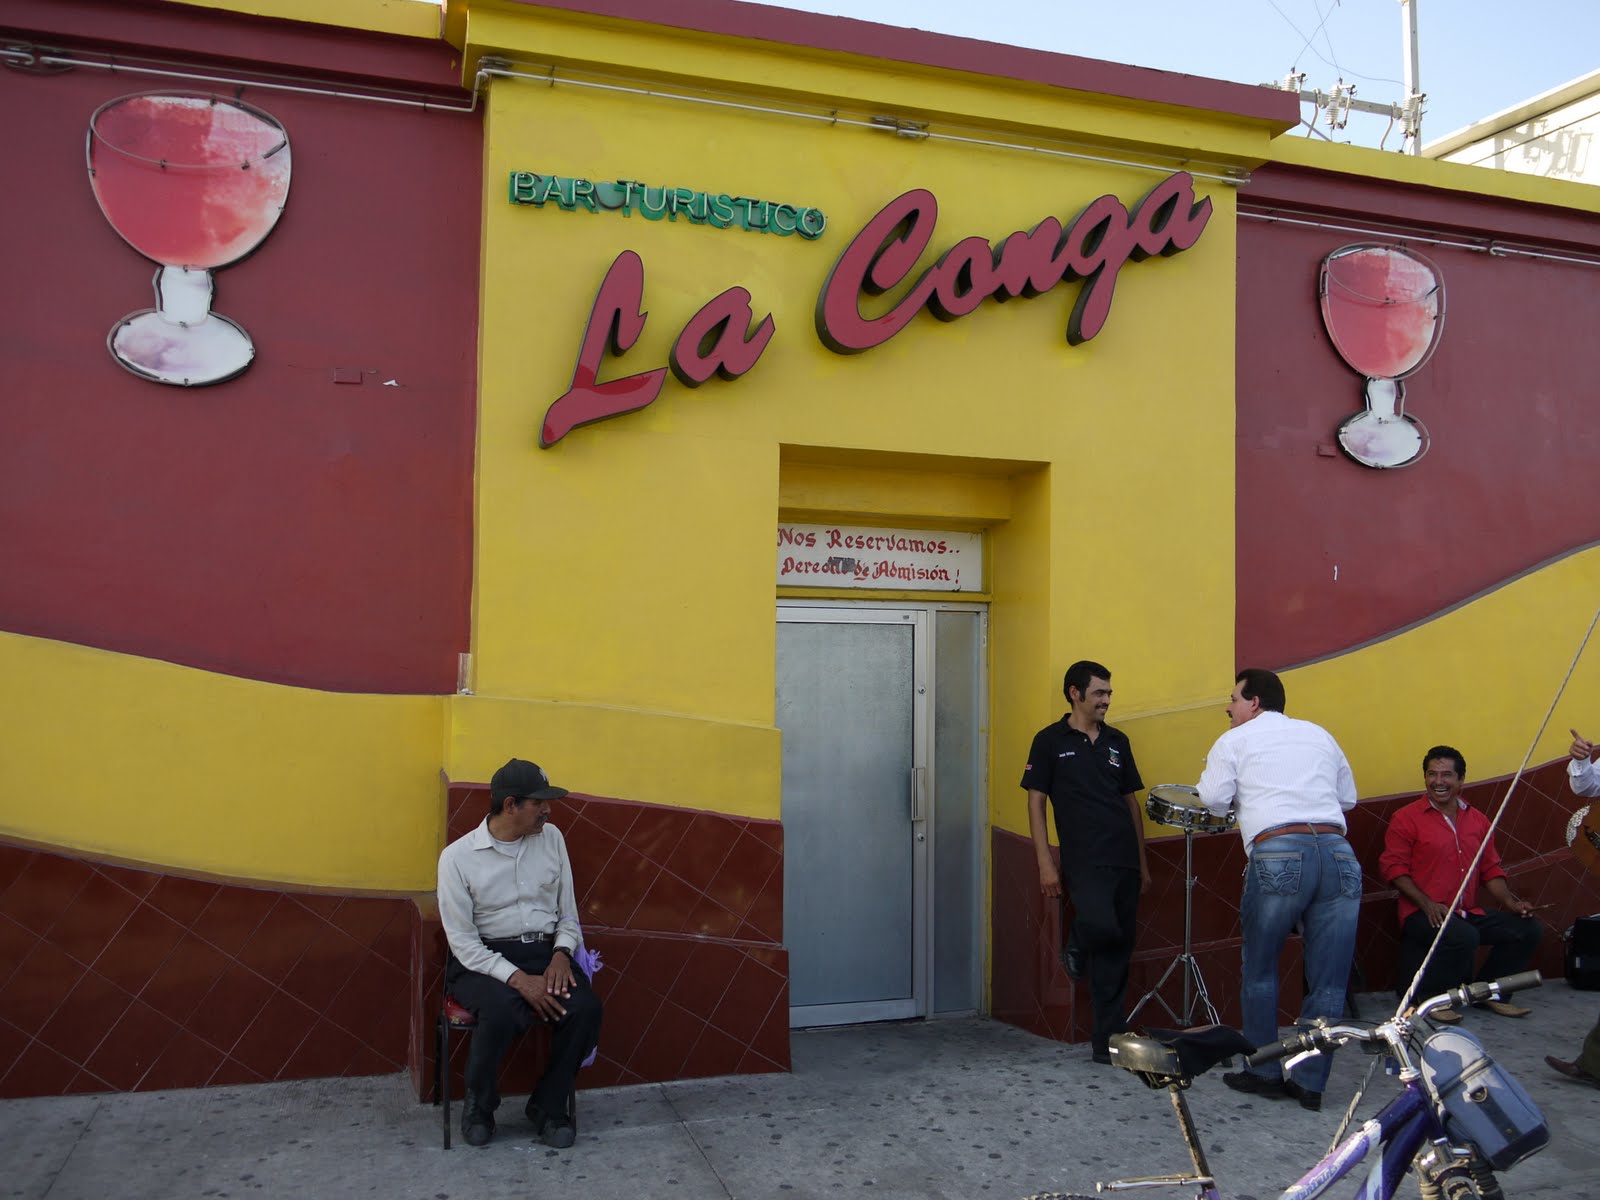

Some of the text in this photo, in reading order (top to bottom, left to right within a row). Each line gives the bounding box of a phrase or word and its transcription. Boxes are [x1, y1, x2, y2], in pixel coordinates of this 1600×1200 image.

[509, 171, 828, 240] BAR TURISTICO
[538, 171, 1213, 450] La Conga
[777, 527, 817, 548] Nos
[853, 559, 870, 580] de
